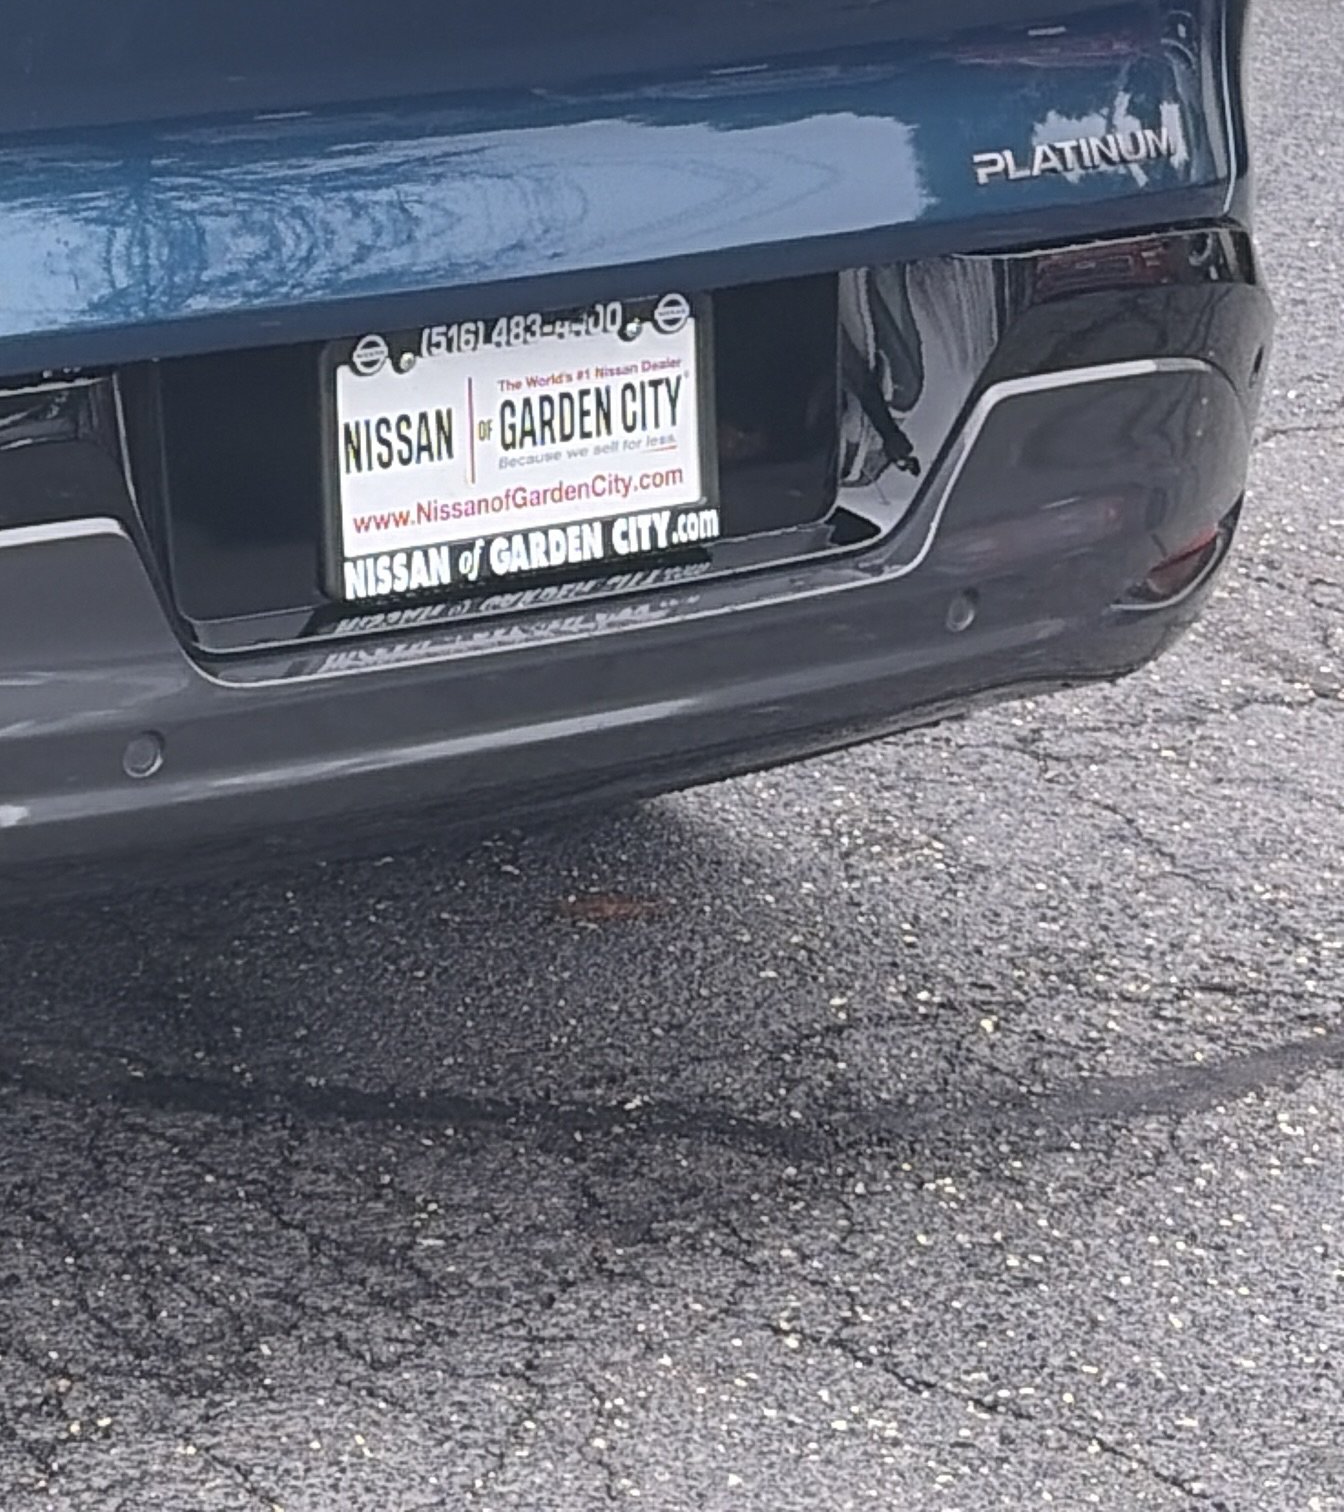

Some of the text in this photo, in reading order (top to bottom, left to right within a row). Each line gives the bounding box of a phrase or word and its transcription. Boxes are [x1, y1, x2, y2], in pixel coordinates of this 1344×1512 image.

[972, 127, 1178, 185] PLATINUM
[420, 320, 486, 357] (516)
[497, 379, 522, 393] The
[526, 373, 573, 388] World's
[595, 364, 639, 379] Nissan
[641, 358, 682, 373] Dealer
[343, 375, 682, 474] NISSAN OF GARDEN CITY
[498, 450, 562, 470] Because
[566, 447, 589, 459] we
[593, 440, 619, 455] sell
[622, 437, 642, 451] for
[353, 466, 684, 534] www.NissanofGardenCity.com
[344, 546, 451, 600] NISSAN
[458, 539, 483, 581] of
[490, 521, 603, 575] GARDEN
[612, 507, 720, 555] CITY.com
